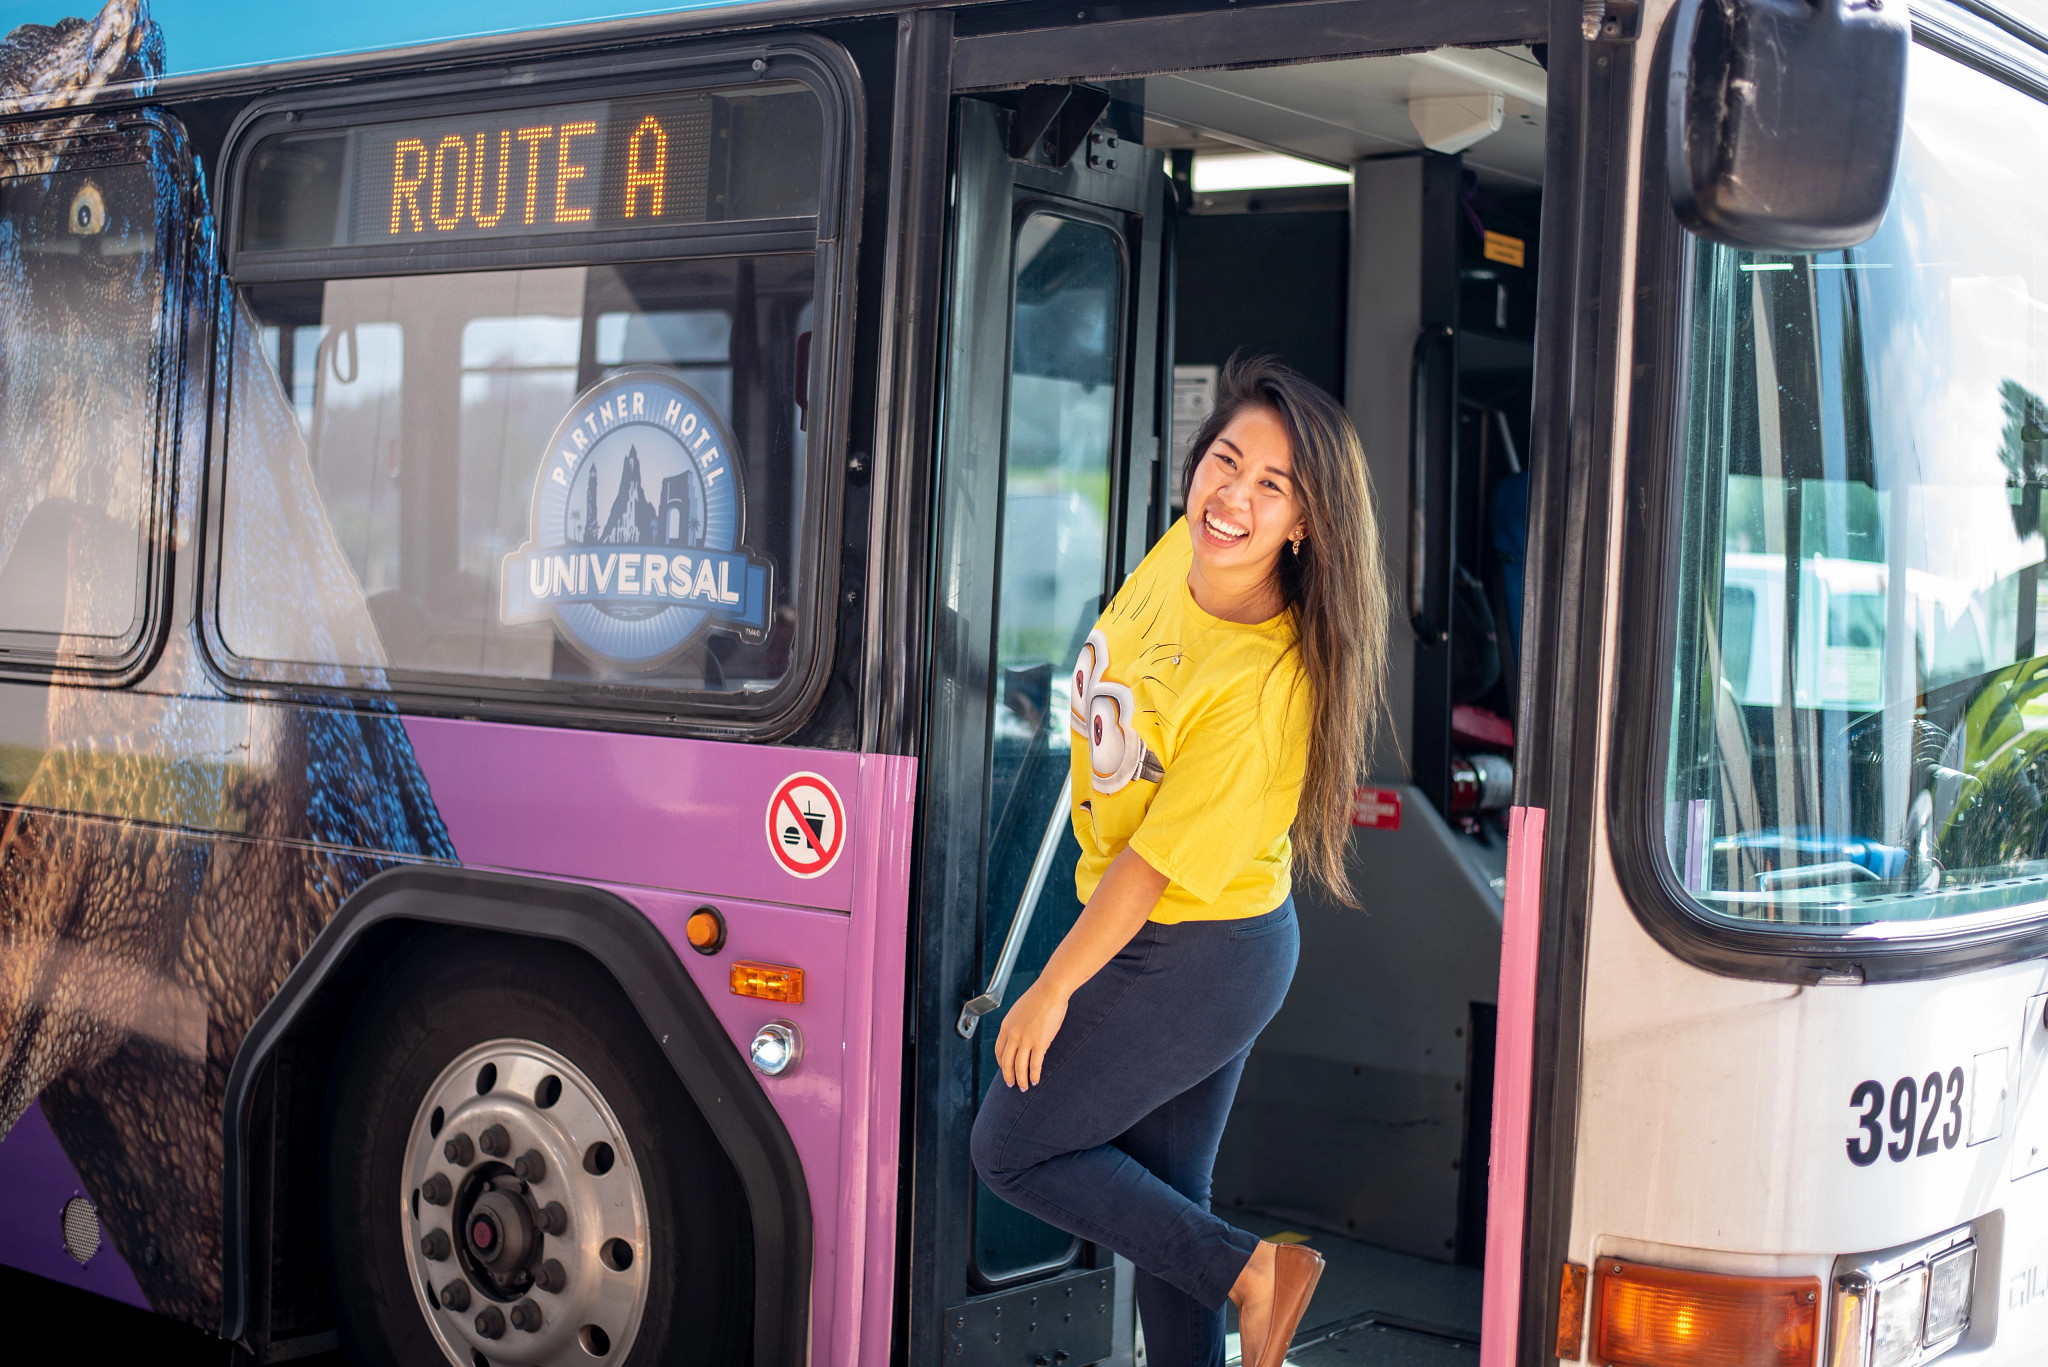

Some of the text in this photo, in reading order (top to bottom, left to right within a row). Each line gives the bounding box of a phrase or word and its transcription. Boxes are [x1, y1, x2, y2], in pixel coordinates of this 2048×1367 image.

[390, 114, 668, 234] ROUTE A
[551, 391, 725, 488] PARTNER HOTEL
[529, 553, 740, 605] UNIVERSAL
[1846, 1065, 1965, 1168] 3923
[2008, 1266, 2048, 1311] GIL
